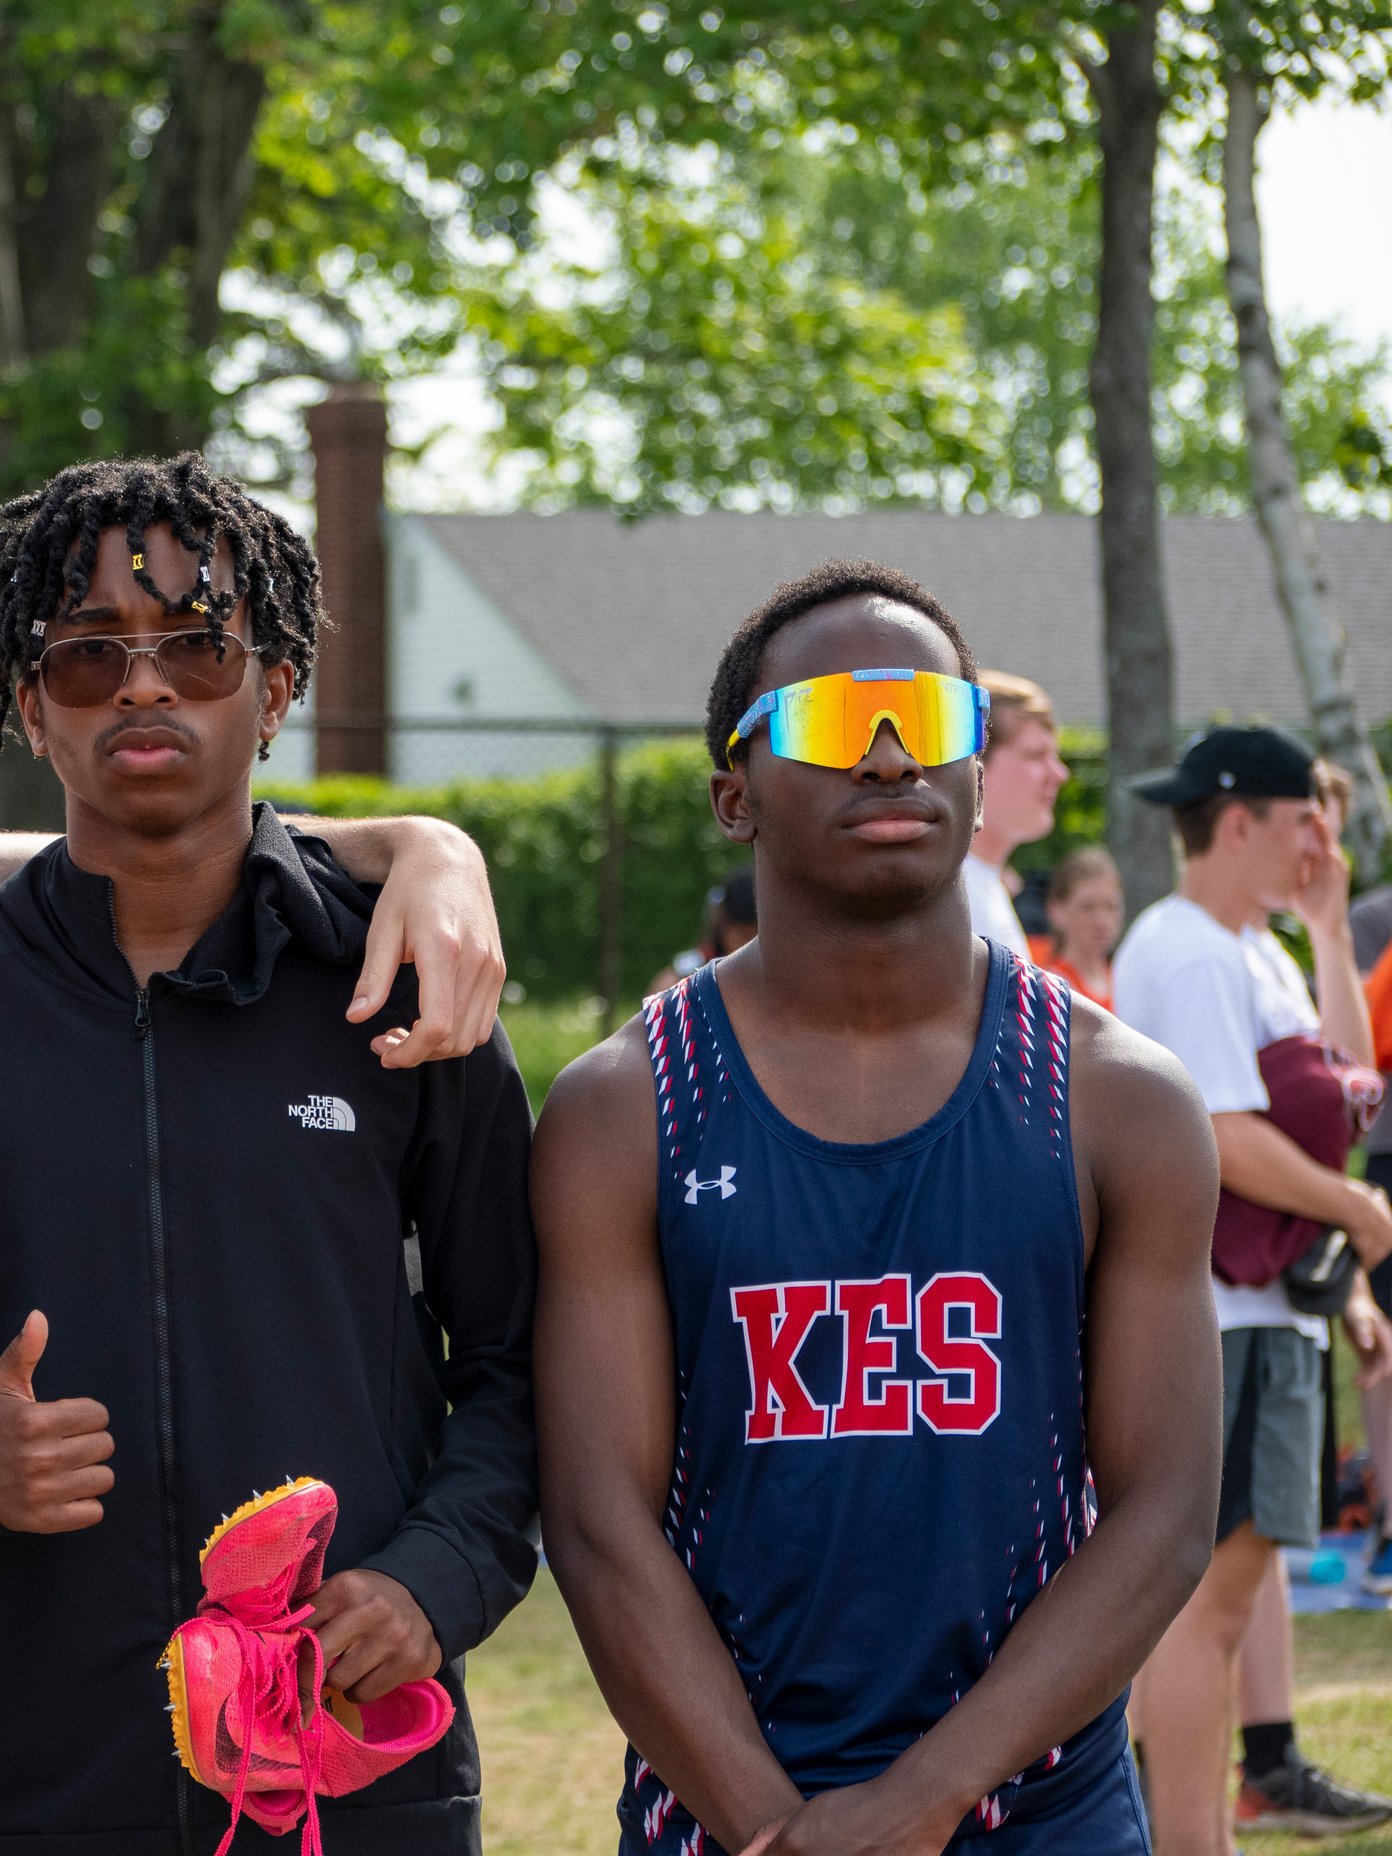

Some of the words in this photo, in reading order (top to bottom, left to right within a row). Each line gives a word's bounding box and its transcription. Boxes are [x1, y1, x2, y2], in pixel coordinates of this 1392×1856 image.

[307, 1095, 333, 1107] THE
[288, 1105, 334, 1118] NORTH
[302, 1117, 334, 1130] FACE
[729, 1271, 1003, 1446] KES
